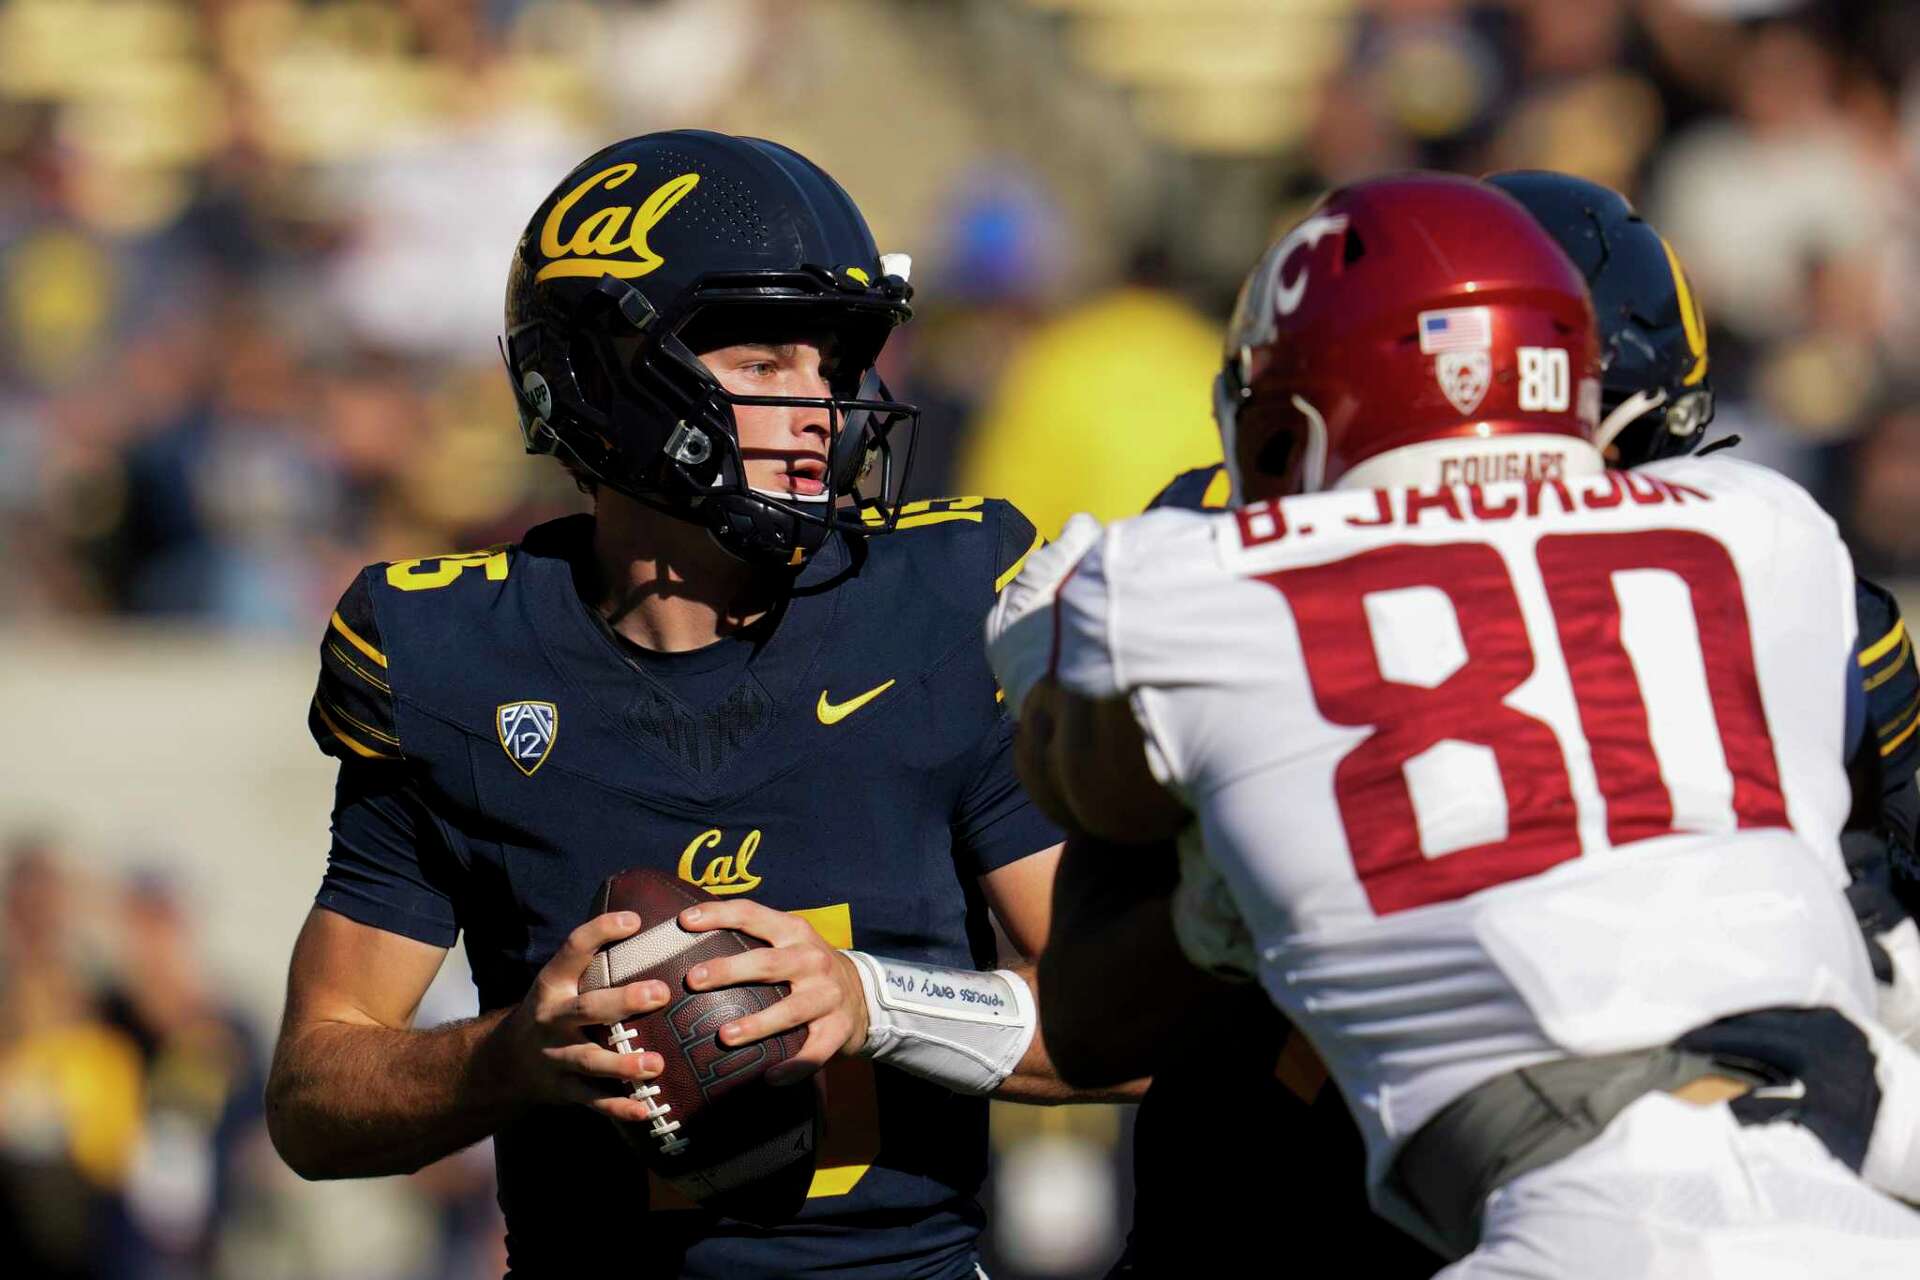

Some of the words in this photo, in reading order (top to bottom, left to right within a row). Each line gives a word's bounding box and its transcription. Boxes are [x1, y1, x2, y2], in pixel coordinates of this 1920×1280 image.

[534, 162, 701, 285] Cal
[1517, 346, 1571, 413] 80
[500, 703, 553, 747] PAC
[513, 731, 543, 760] 12
[1247, 528, 1796, 918] 80
[678, 828, 762, 896] Cal
